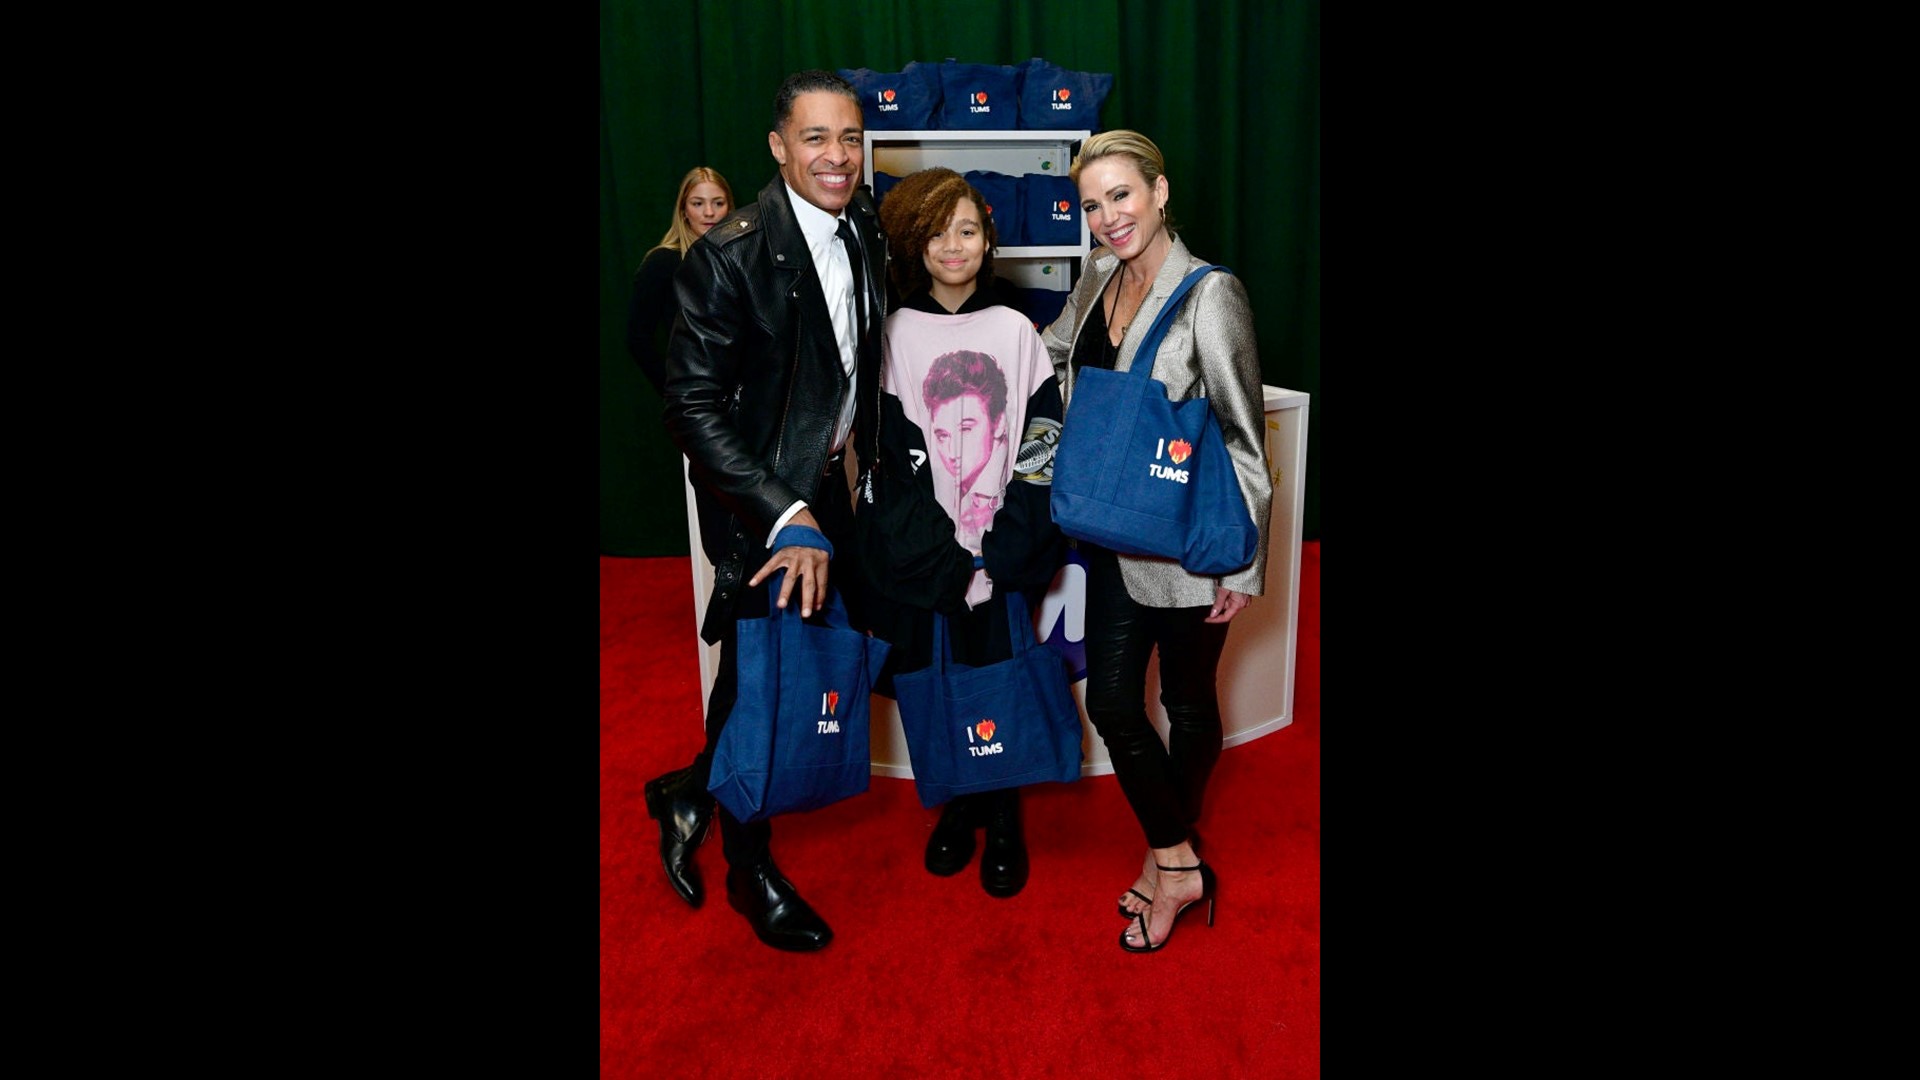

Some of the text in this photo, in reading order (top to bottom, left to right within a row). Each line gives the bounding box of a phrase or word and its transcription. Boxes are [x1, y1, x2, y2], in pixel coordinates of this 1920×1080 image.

[878, 104, 899, 112] TUMS
[970, 105, 990, 113] TUMS
[1051, 102, 1072, 110] TUMS
[1052, 213, 1071, 221] TUMS
[1156, 438, 1164, 460] I
[1149, 463, 1189, 484] TUMS
[822, 692, 827, 716] I
[817, 720, 840, 734] TUMS
[966, 726, 974, 743] I
[968, 742, 1004, 757] TUMS
